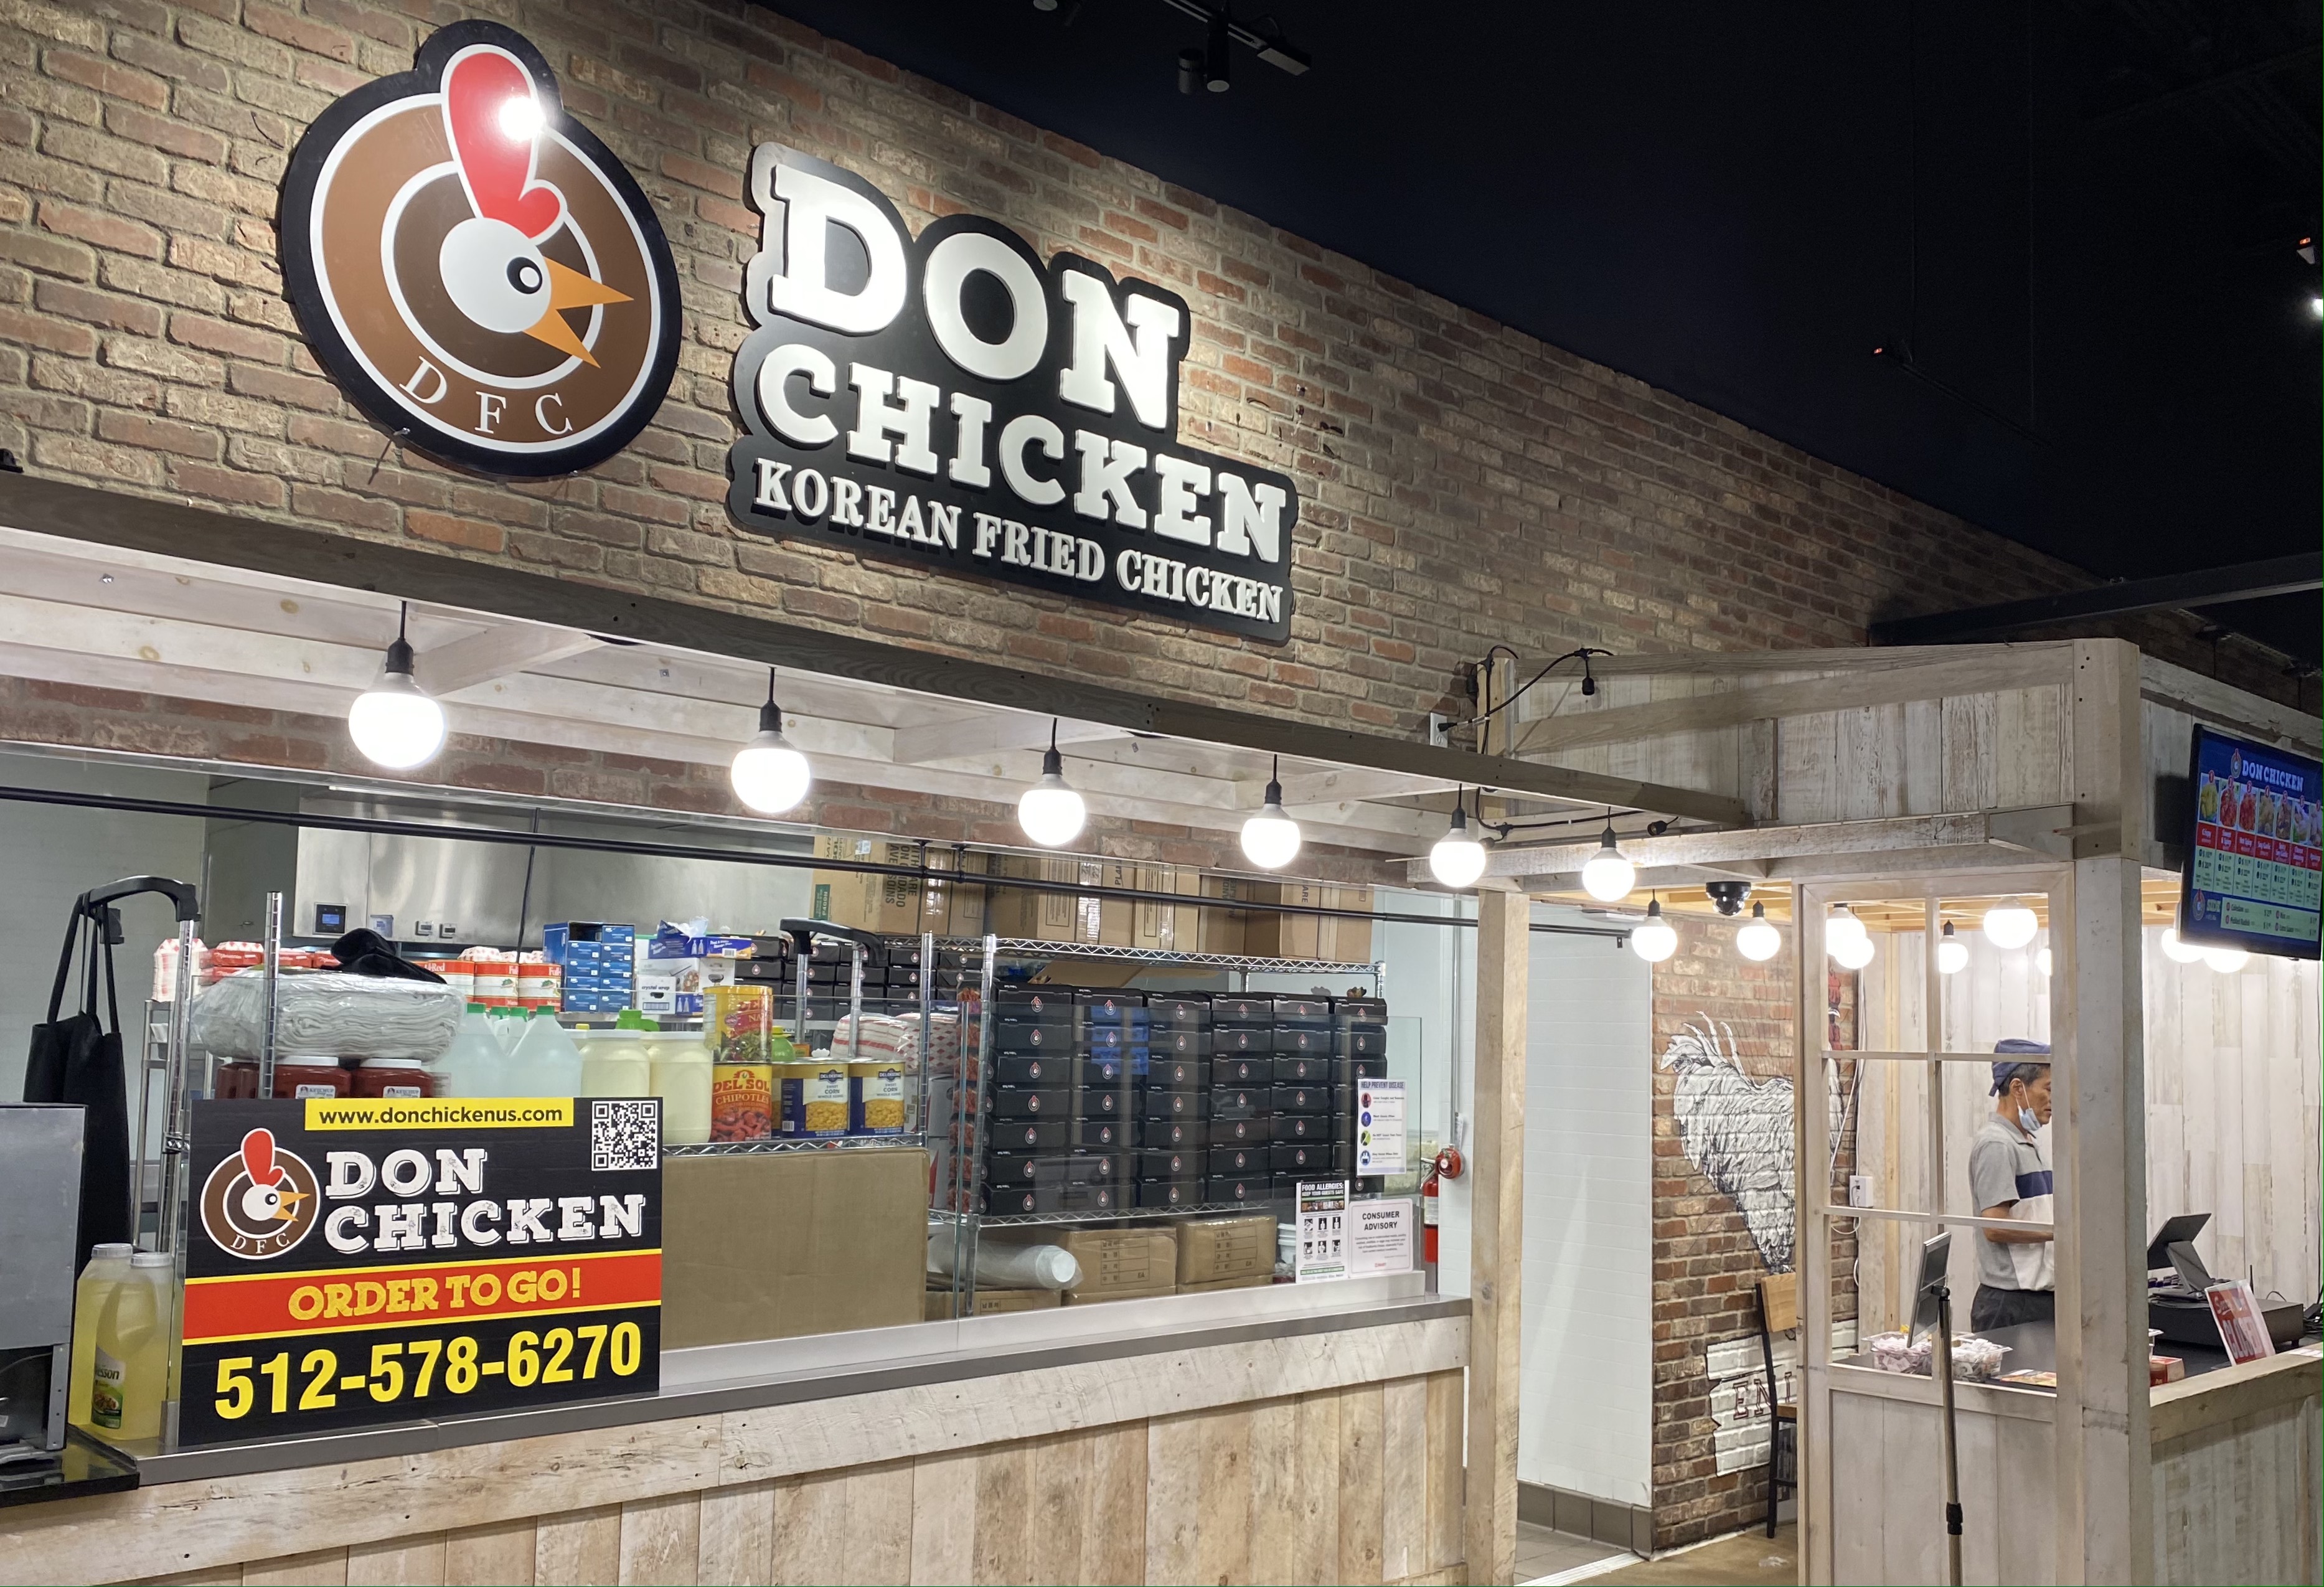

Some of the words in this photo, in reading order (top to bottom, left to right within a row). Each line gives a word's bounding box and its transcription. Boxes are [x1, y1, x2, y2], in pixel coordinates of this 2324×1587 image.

[768, 164, 1179, 430] DON
[759, 343, 1286, 563] CHICKEN
[753, 458, 961, 550] KOREAN
[972, 511, 1105, 581] FRIED
[1116, 550, 1282, 623] CHICKEN
[2242, 760, 2262, 781] DON
[2264, 766, 2303, 792] CHICKEN
[900, 846, 910, 859] ON
[908, 877, 918, 897] ARE
[713, 1080, 743, 1093] DEL
[746, 1079, 769, 1092] SOL
[716, 1093, 769, 1104] CHIPOTLES
[319, 1106, 563, 1125] www.donchickenus.com
[324, 1148, 489, 1198] DON
[1316, 1182, 1344, 1190] ALLERGIES:
[324, 1194, 646, 1253] CHICKEN
[1362, 1211, 1400, 1220] CONSUMER
[1364, 1222, 1398, 1231] ADVISORY
[288, 1277, 438, 1321] ORDER
[445, 1271, 504, 1309] TO
[507, 1267, 581, 1304] GO!
[215, 1321, 641, 1420] 512-578-6270
